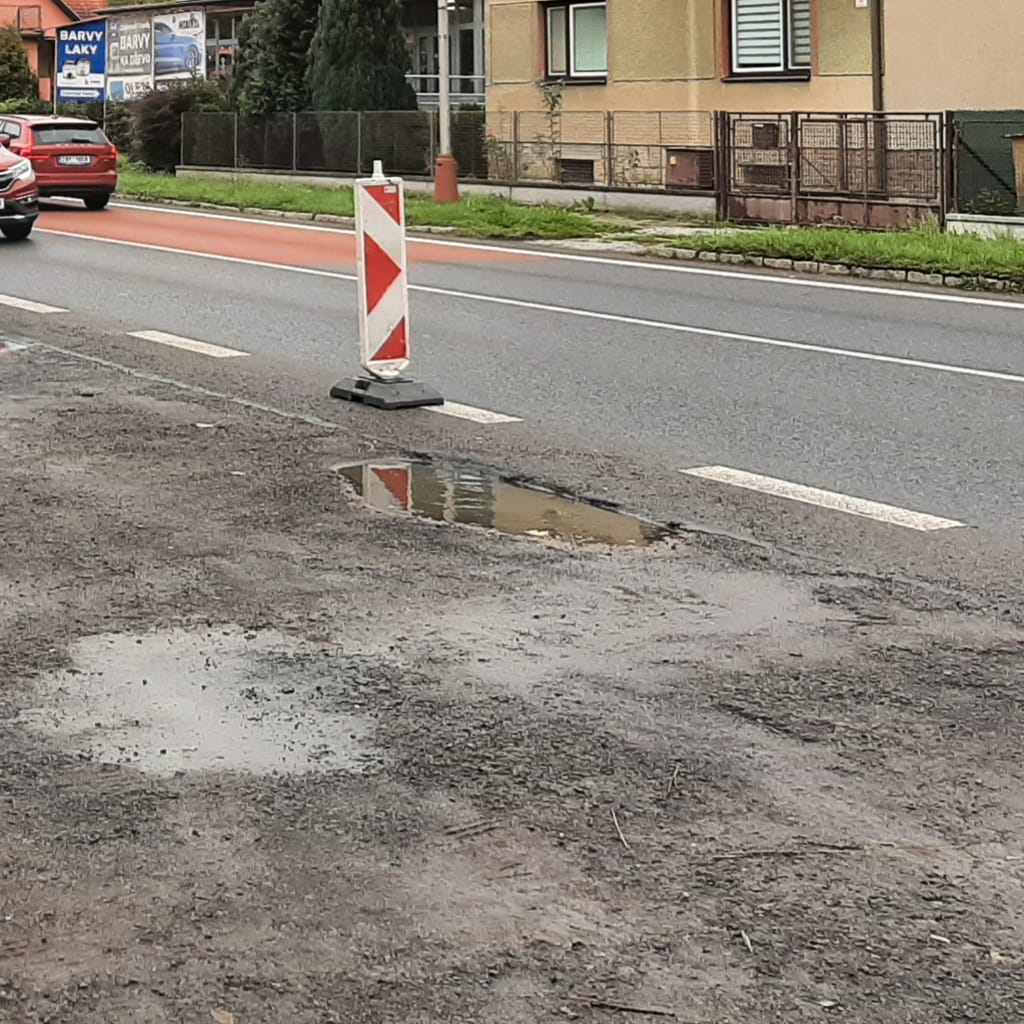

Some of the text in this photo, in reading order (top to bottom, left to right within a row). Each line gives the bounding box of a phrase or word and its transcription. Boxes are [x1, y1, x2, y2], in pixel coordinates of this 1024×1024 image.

[59, 30, 103, 42] BARVY
[119, 32, 151, 50] BARVY
[64, 43, 98, 55] LAKY
